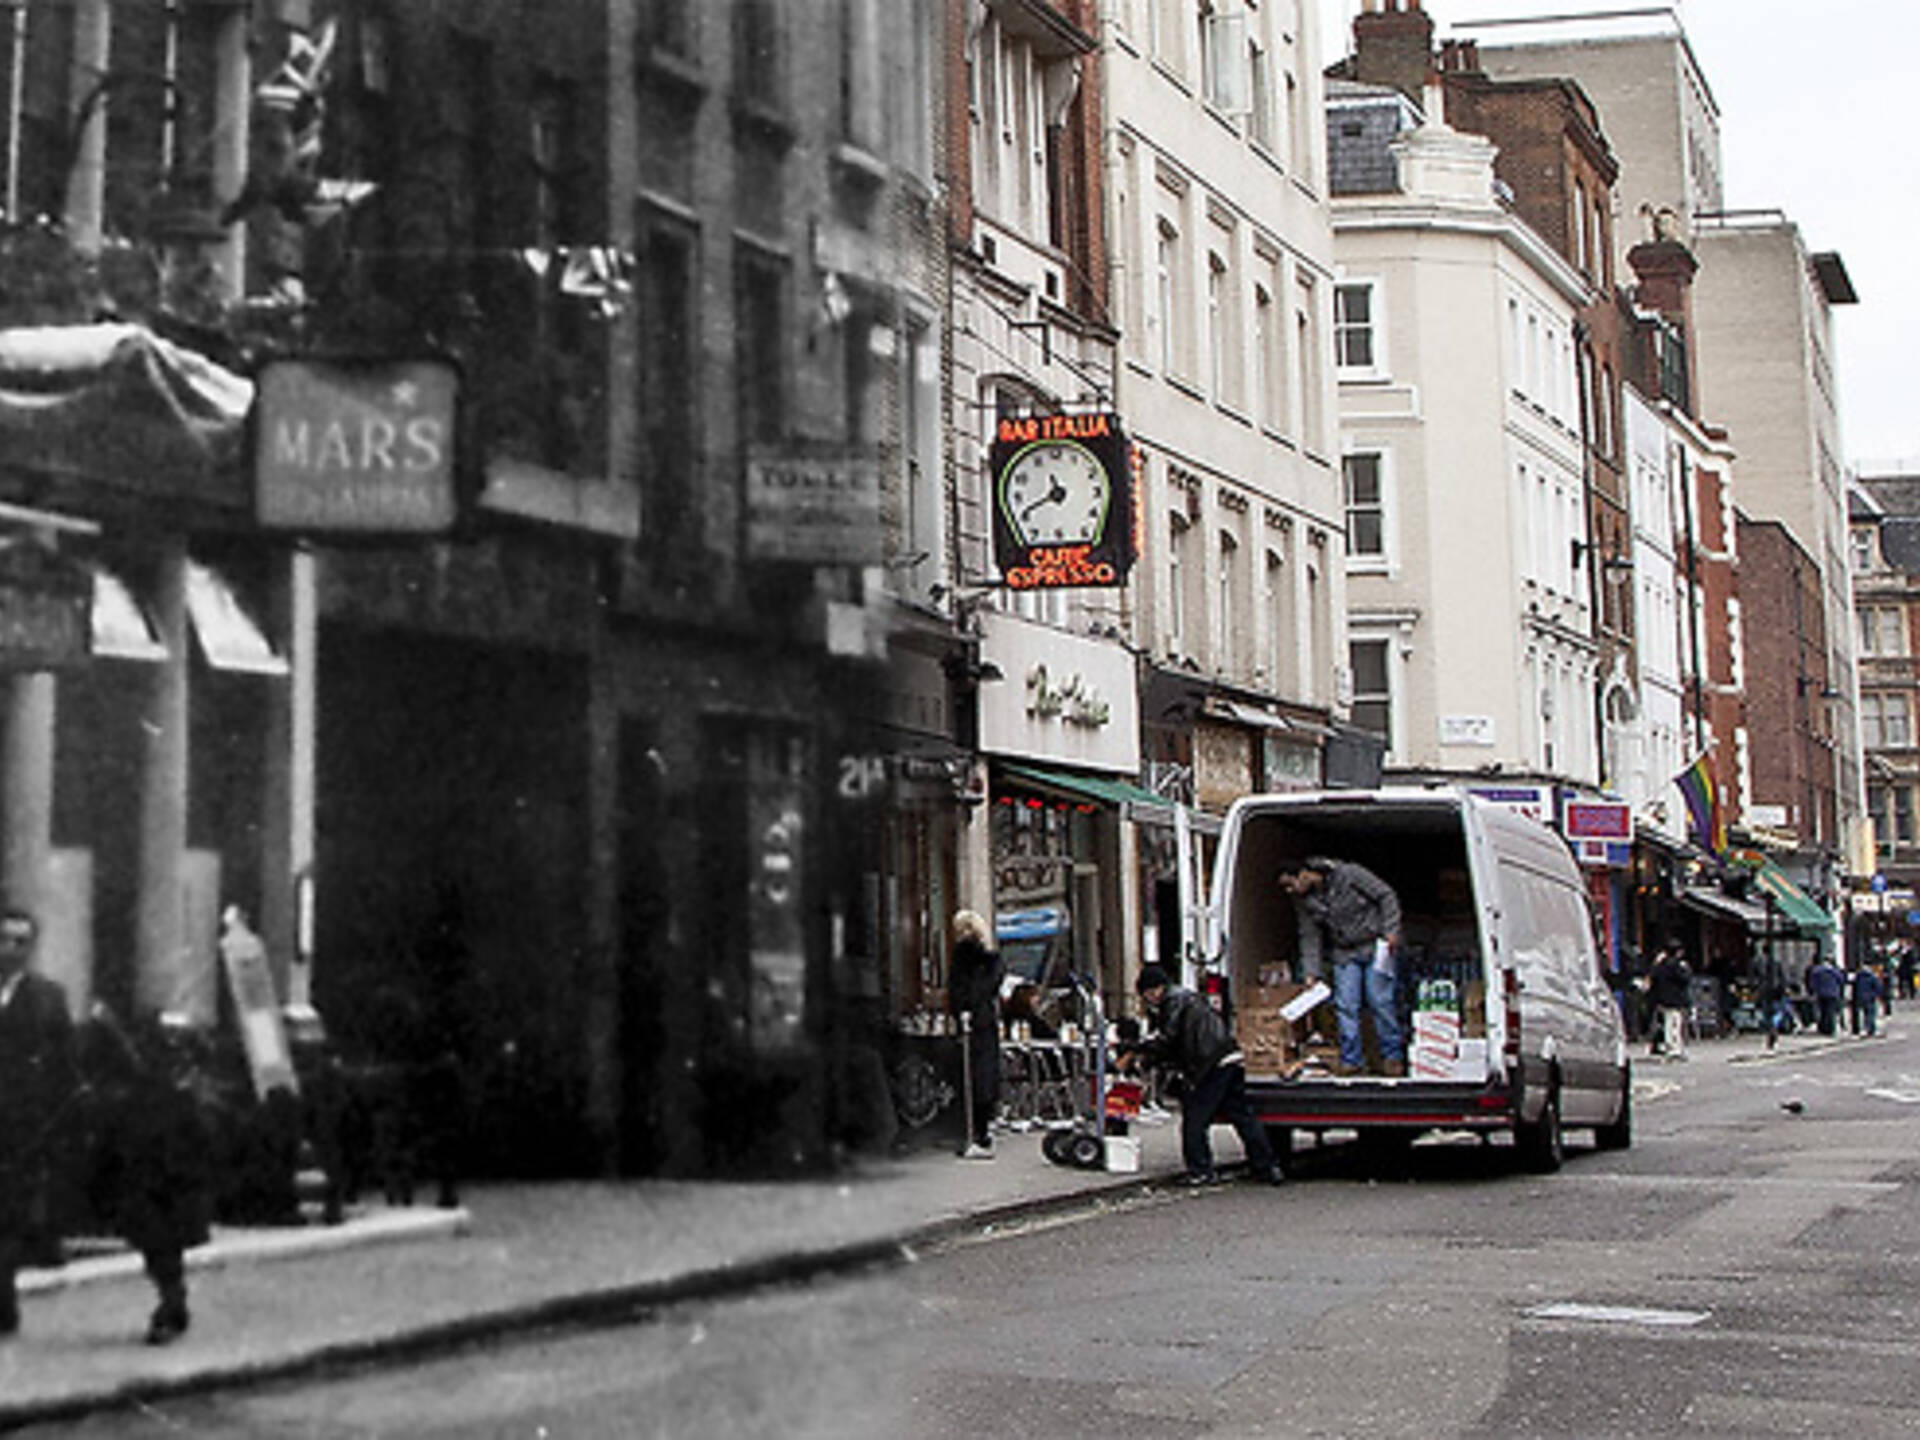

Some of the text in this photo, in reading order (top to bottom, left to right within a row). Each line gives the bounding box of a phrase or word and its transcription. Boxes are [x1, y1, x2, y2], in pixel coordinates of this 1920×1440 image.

[275, 416, 442, 471] MARS
[1000, 414, 1110, 442] BAR ITALIA
